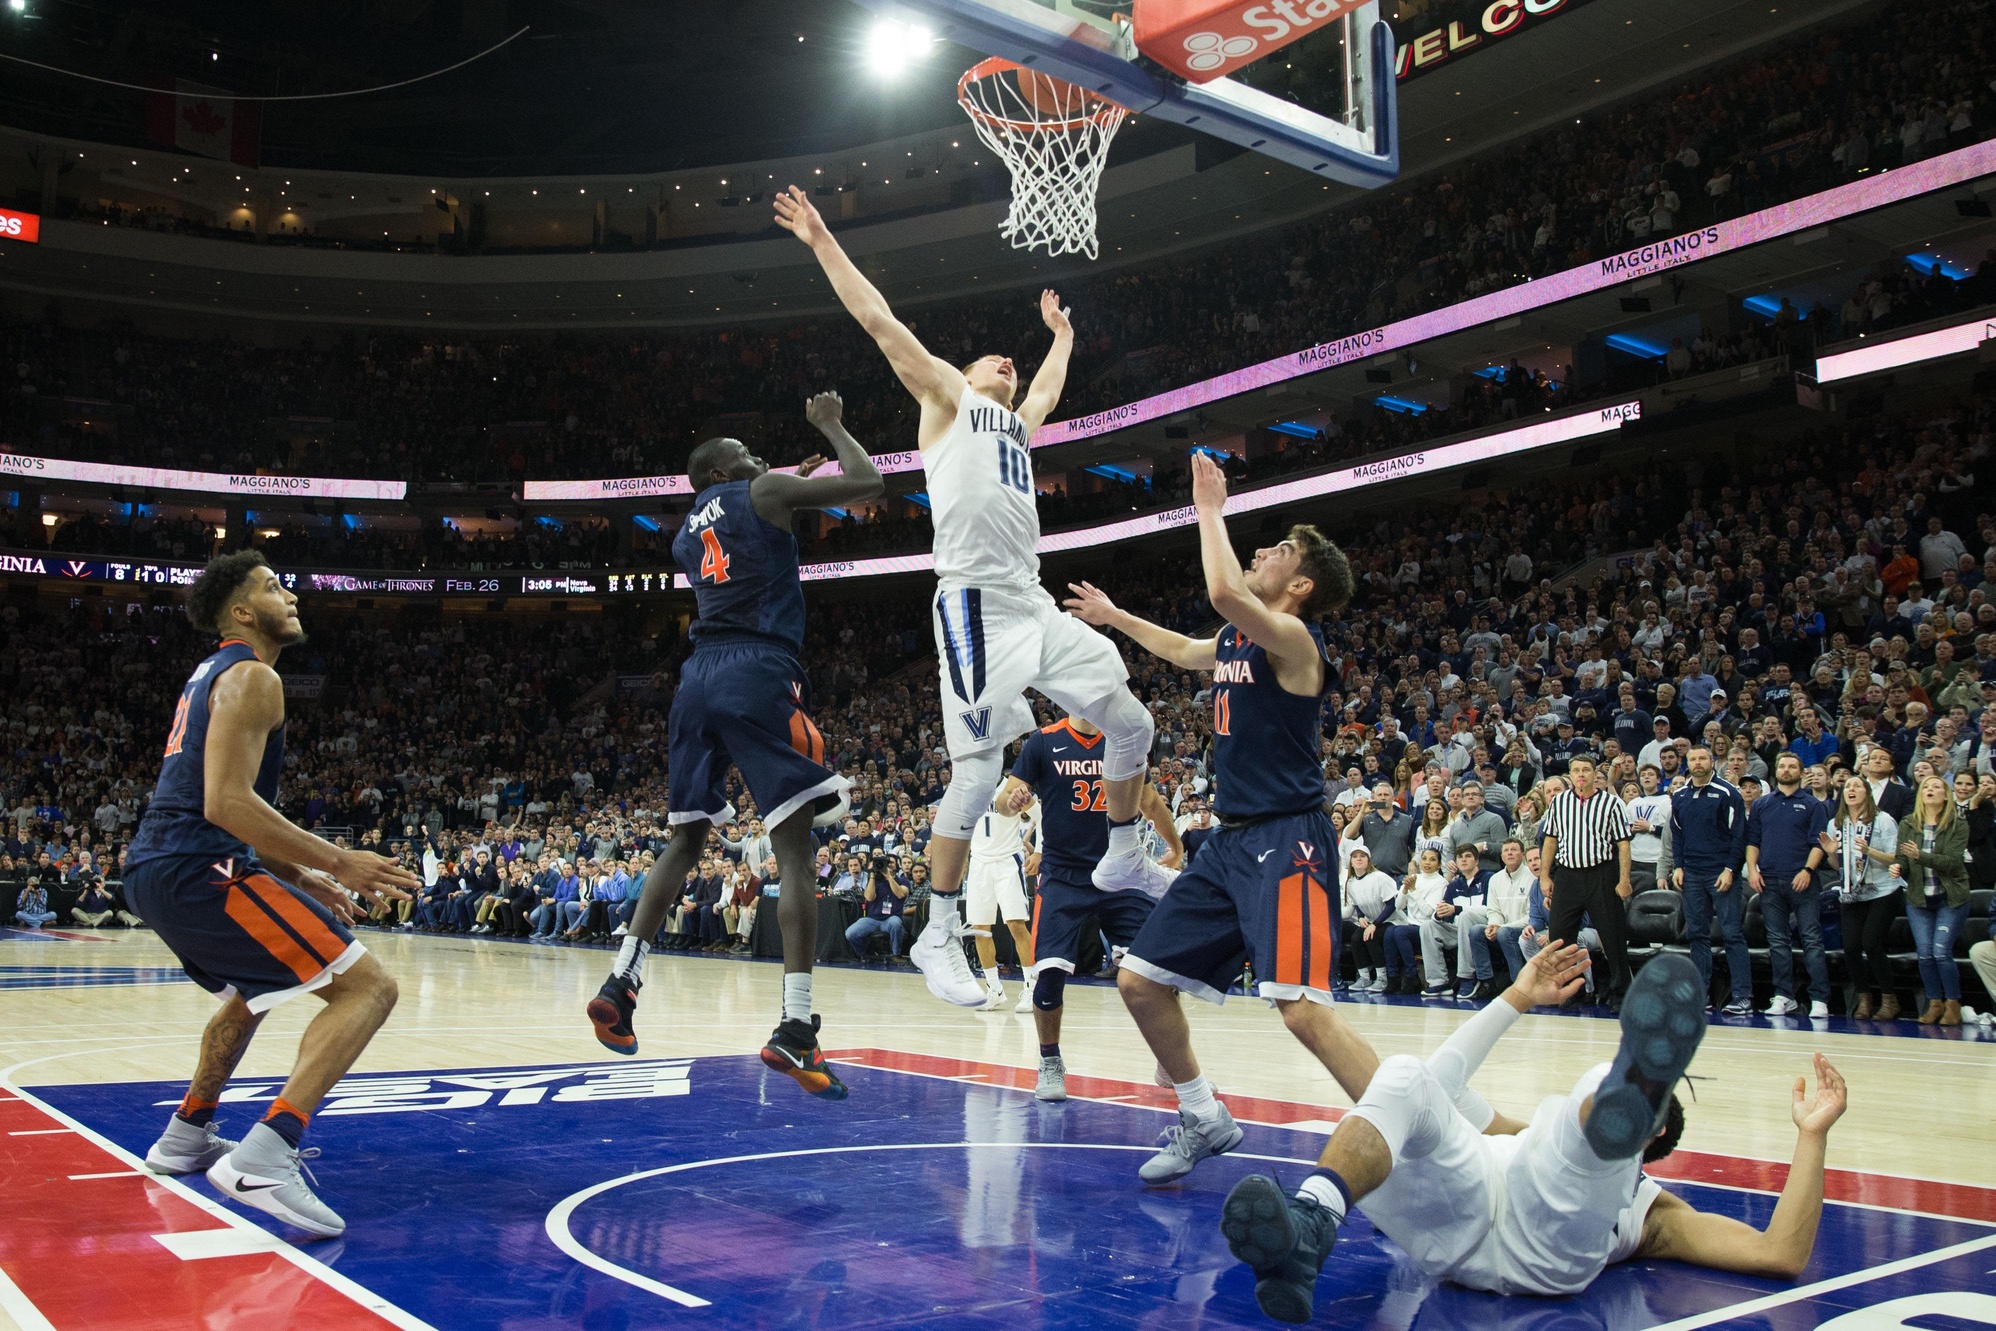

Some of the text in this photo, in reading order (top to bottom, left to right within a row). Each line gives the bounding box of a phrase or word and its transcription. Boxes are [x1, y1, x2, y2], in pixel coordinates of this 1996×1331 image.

[1601, 227, 1718, 276] MAGGIANO'S
[1627, 254, 1691, 278] LITTLE ITALY
[1299, 329, 1384, 366] MAGGIANO'S
[1068, 403, 1138, 433] MAGGIANO'S
[996, 438, 1029, 494] 10
[1353, 453, 1424, 479] MAGGIANO'S
[229, 476, 311, 489] MAGGIANO'S
[602, 477, 677, 491] MAGGIANO'S
[700, 526, 731, 585] 4
[114, 569, 125, 580] 8
[141, 571, 165, 583] 1 0
[344, 577, 378, 590] GAME
[385, 579, 435, 591] THRONES
[478, 579, 499, 591] 26
[528, 579, 552, 590] 3:05
[570, 585, 596, 593] Virginia
[959, 706, 992, 742] V
[1214, 689, 1231, 736] 11
[1071, 780, 1108, 812] 32
[985, 816, 991, 837] 1
